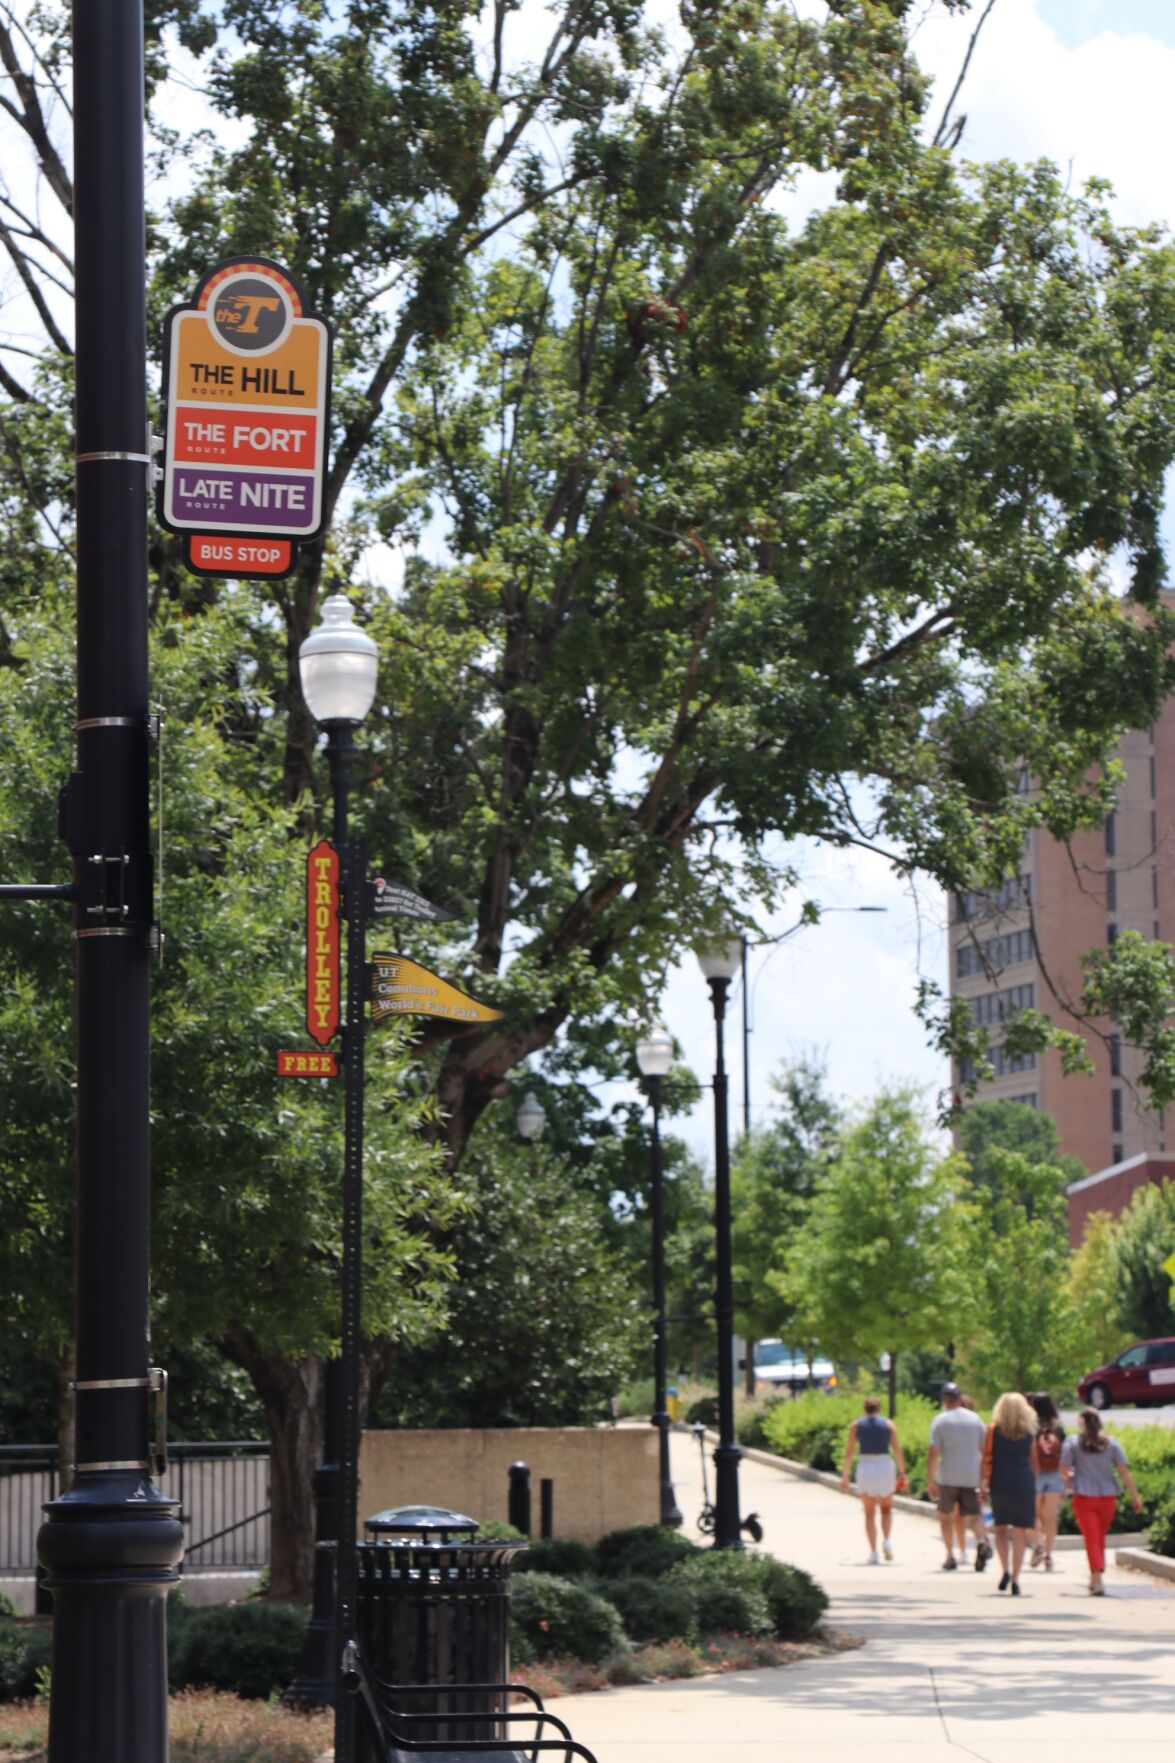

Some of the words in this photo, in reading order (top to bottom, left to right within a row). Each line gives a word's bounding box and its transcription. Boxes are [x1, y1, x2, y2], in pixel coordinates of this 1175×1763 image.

[216, 309, 241, 323] the
[232, 296, 281, 333] T
[190, 364, 234, 385] THE
[241, 367, 305, 395] HILL
[192, 387, 233, 397] ROUTE
[184, 423, 226, 443] THE
[233, 425, 307, 453] FORT
[187, 446, 226, 455] ROUTE
[179, 478, 233, 500] LATE
[240, 482, 306, 510] NITE
[186, 501, 226, 510] ROUTE
[201, 545, 233, 560] BUS
[238, 547, 280, 563] STOP
[314, 858, 332, 1028] TROLLEY
[379, 967, 398, 977] UT
[378, 983, 437, 997] Commons
[379, 1000, 423, 1011] World's
[426, 1001, 449, 1014] Fair
[452, 1007, 478, 1018] Park
[284, 1057, 331, 1072] FREE
